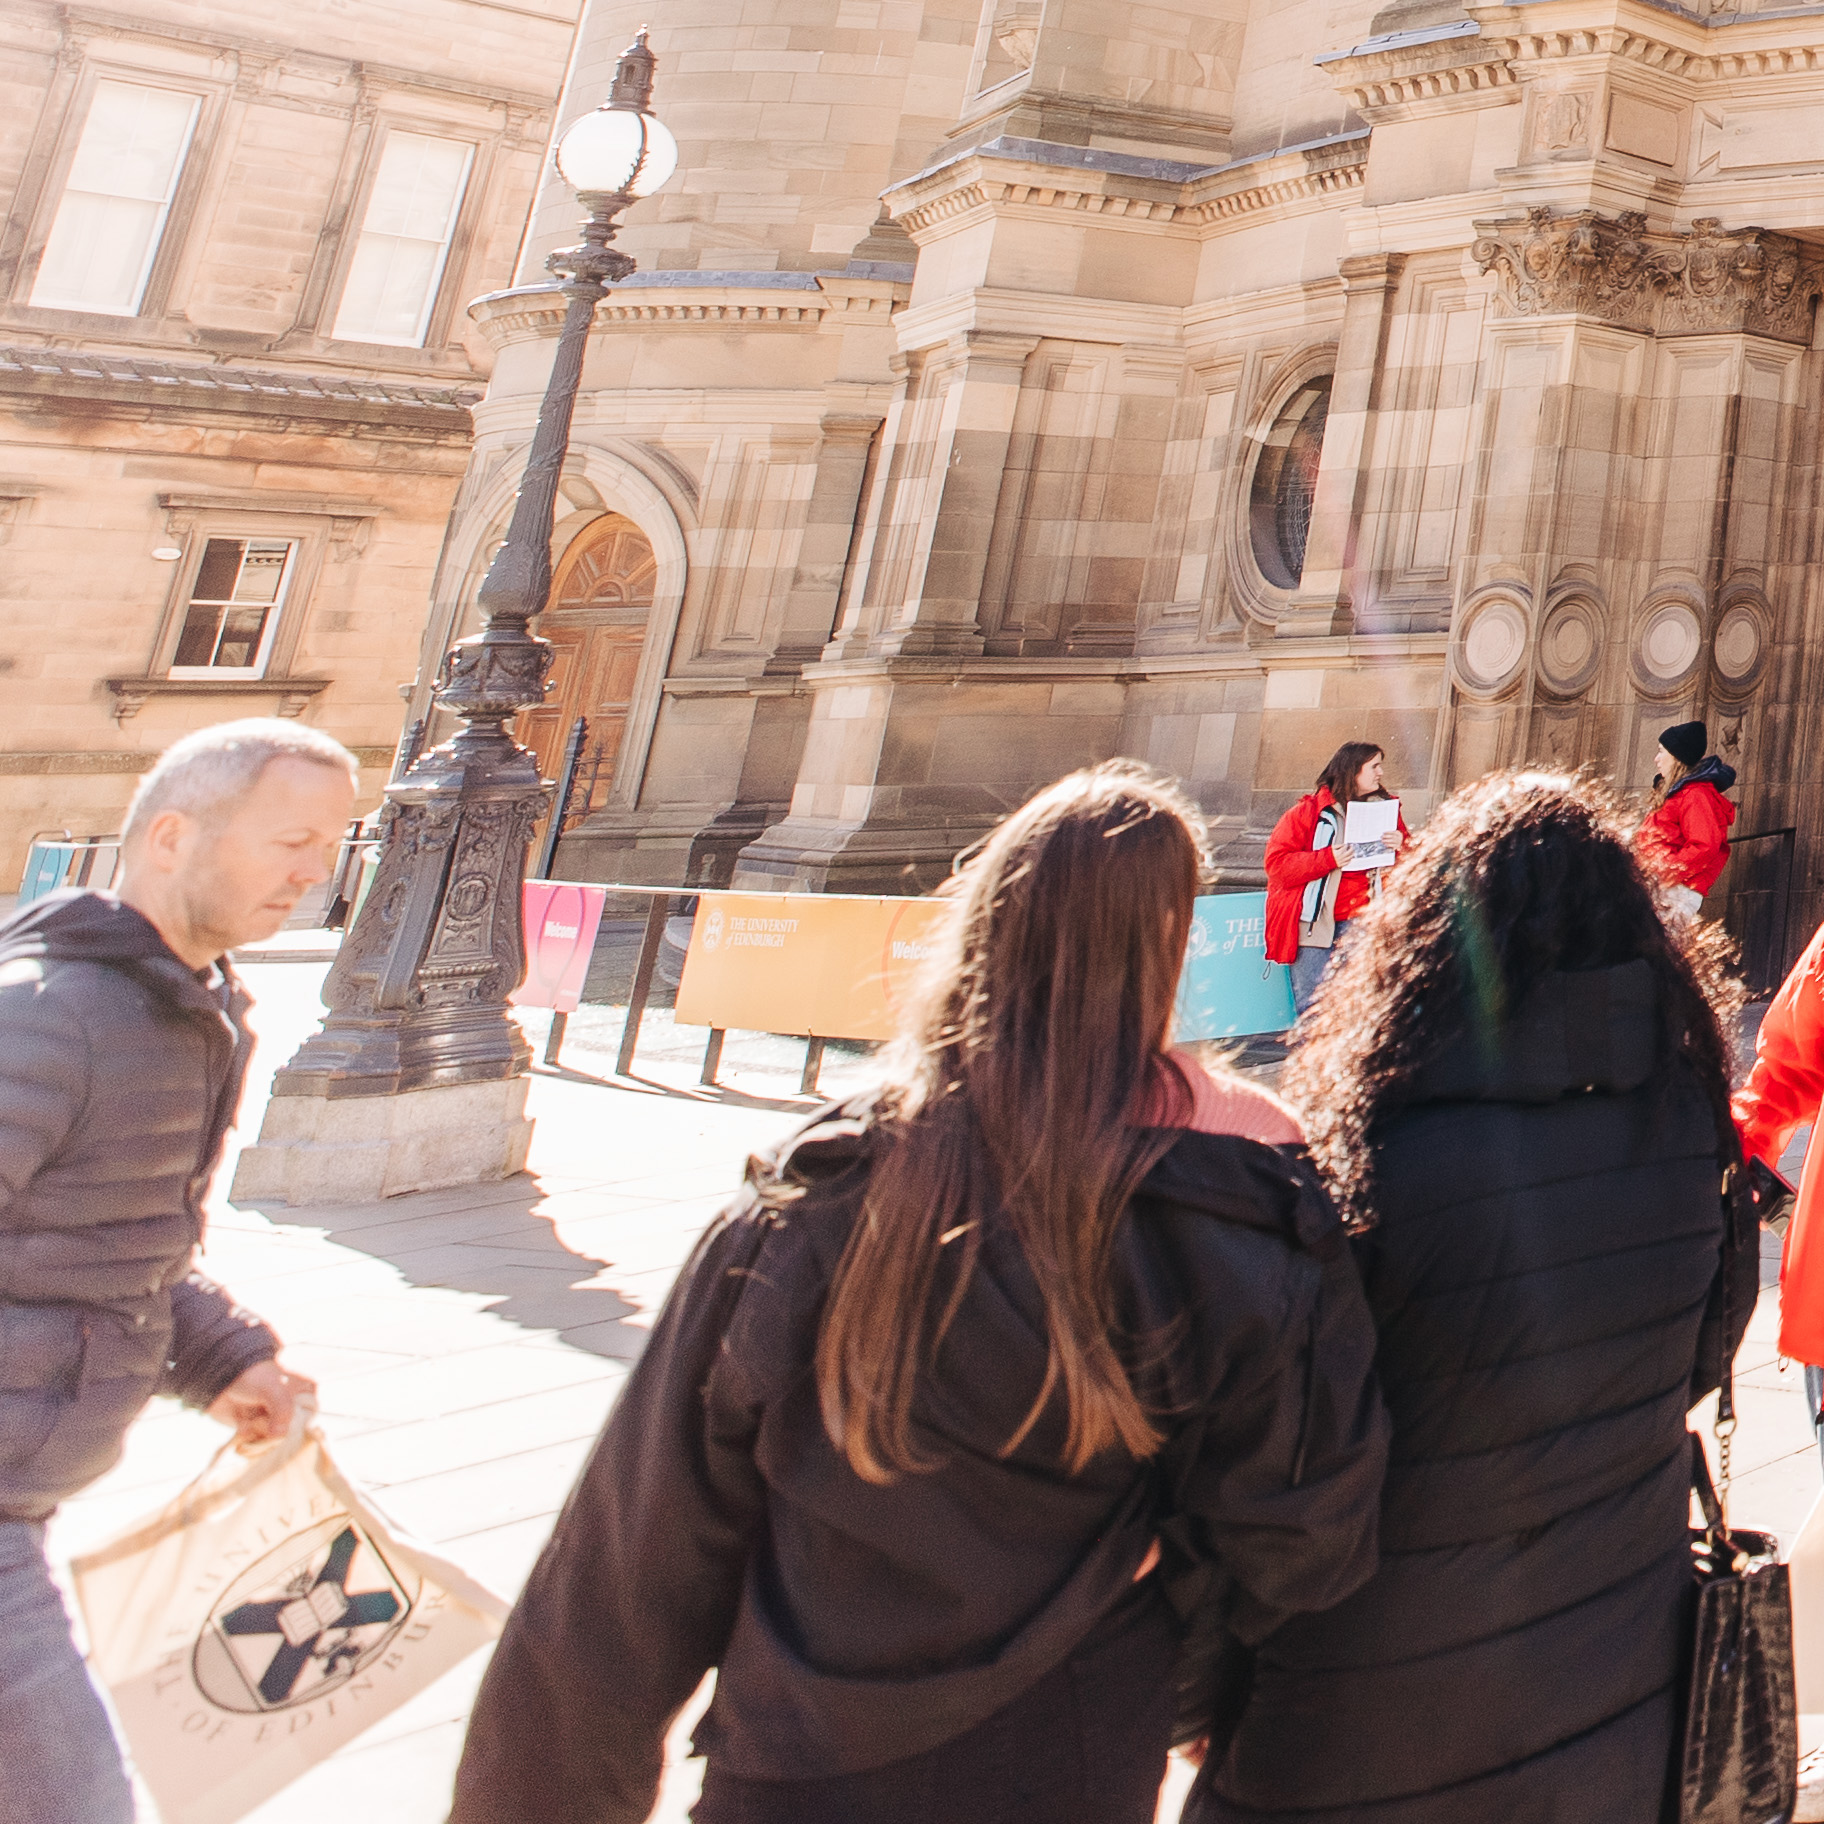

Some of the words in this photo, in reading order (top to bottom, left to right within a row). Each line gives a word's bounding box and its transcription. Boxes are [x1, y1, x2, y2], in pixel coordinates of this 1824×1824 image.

[730, 917, 747, 931] THE
[746, 918, 799, 933] UNIVERSITY
[733, 933, 785, 947] EDINBURGH
[1223, 934, 1241, 955] of
